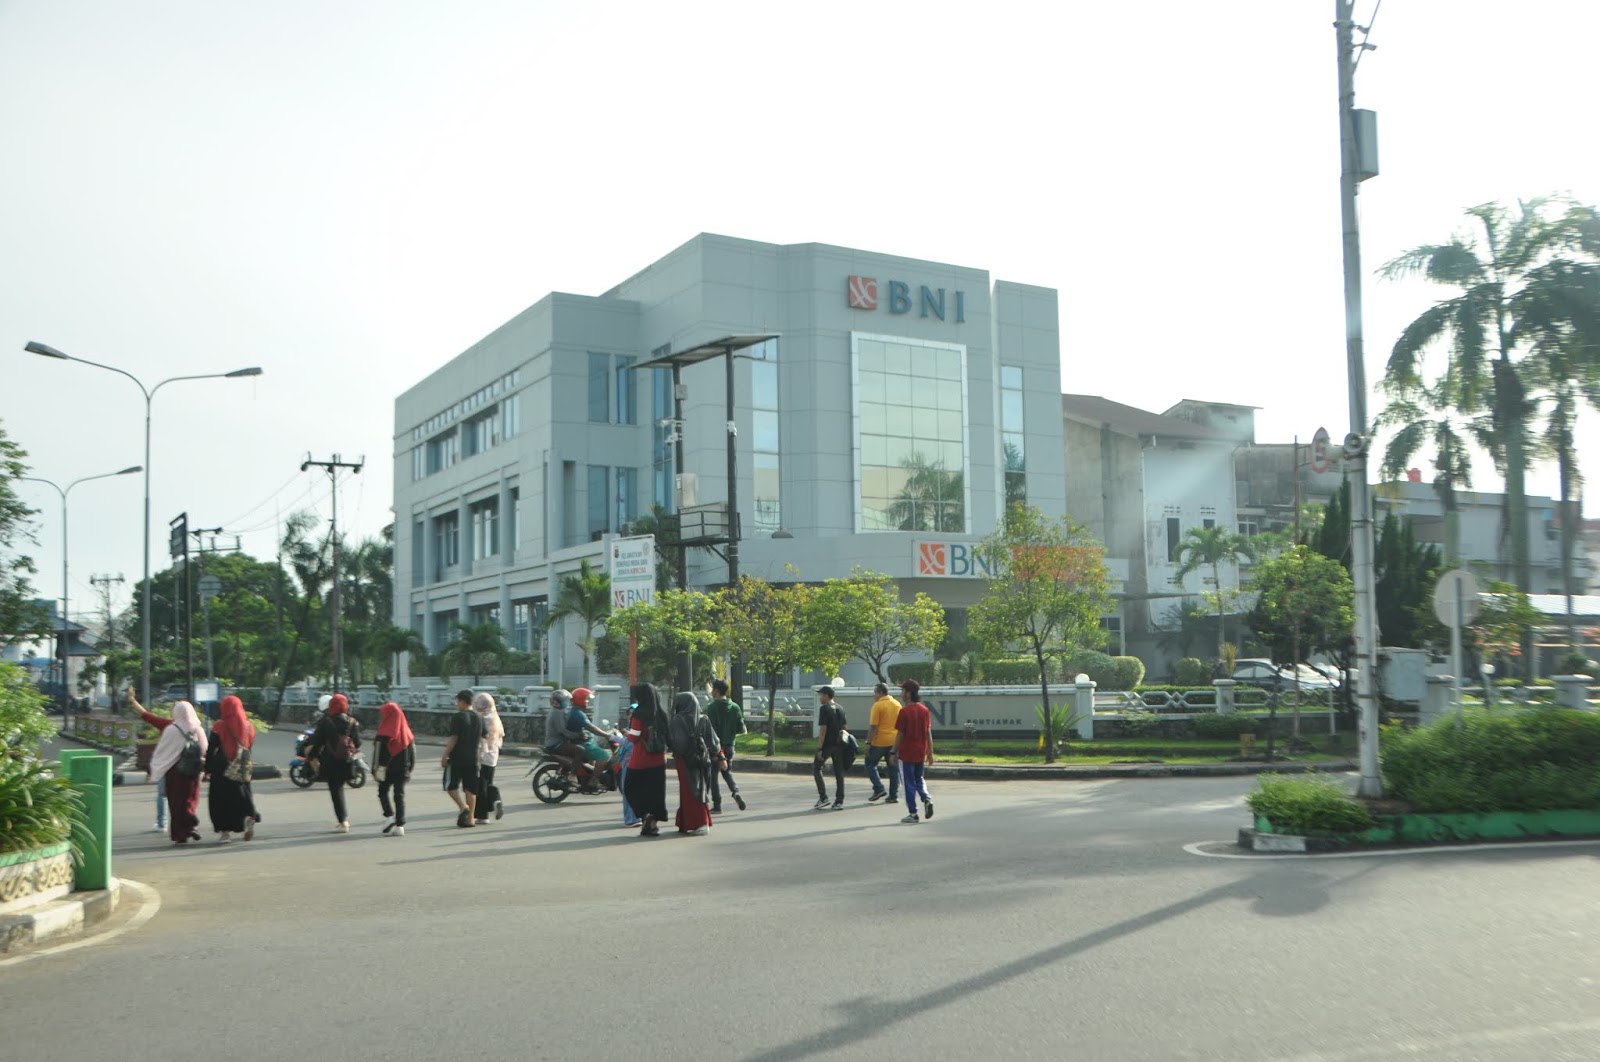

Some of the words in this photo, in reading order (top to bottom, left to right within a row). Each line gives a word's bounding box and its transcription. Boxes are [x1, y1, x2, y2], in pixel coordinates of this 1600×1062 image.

[888, 280, 966, 324] BNI
[627, 588, 650, 607] BNI
[923, 700, 958, 726] NI
